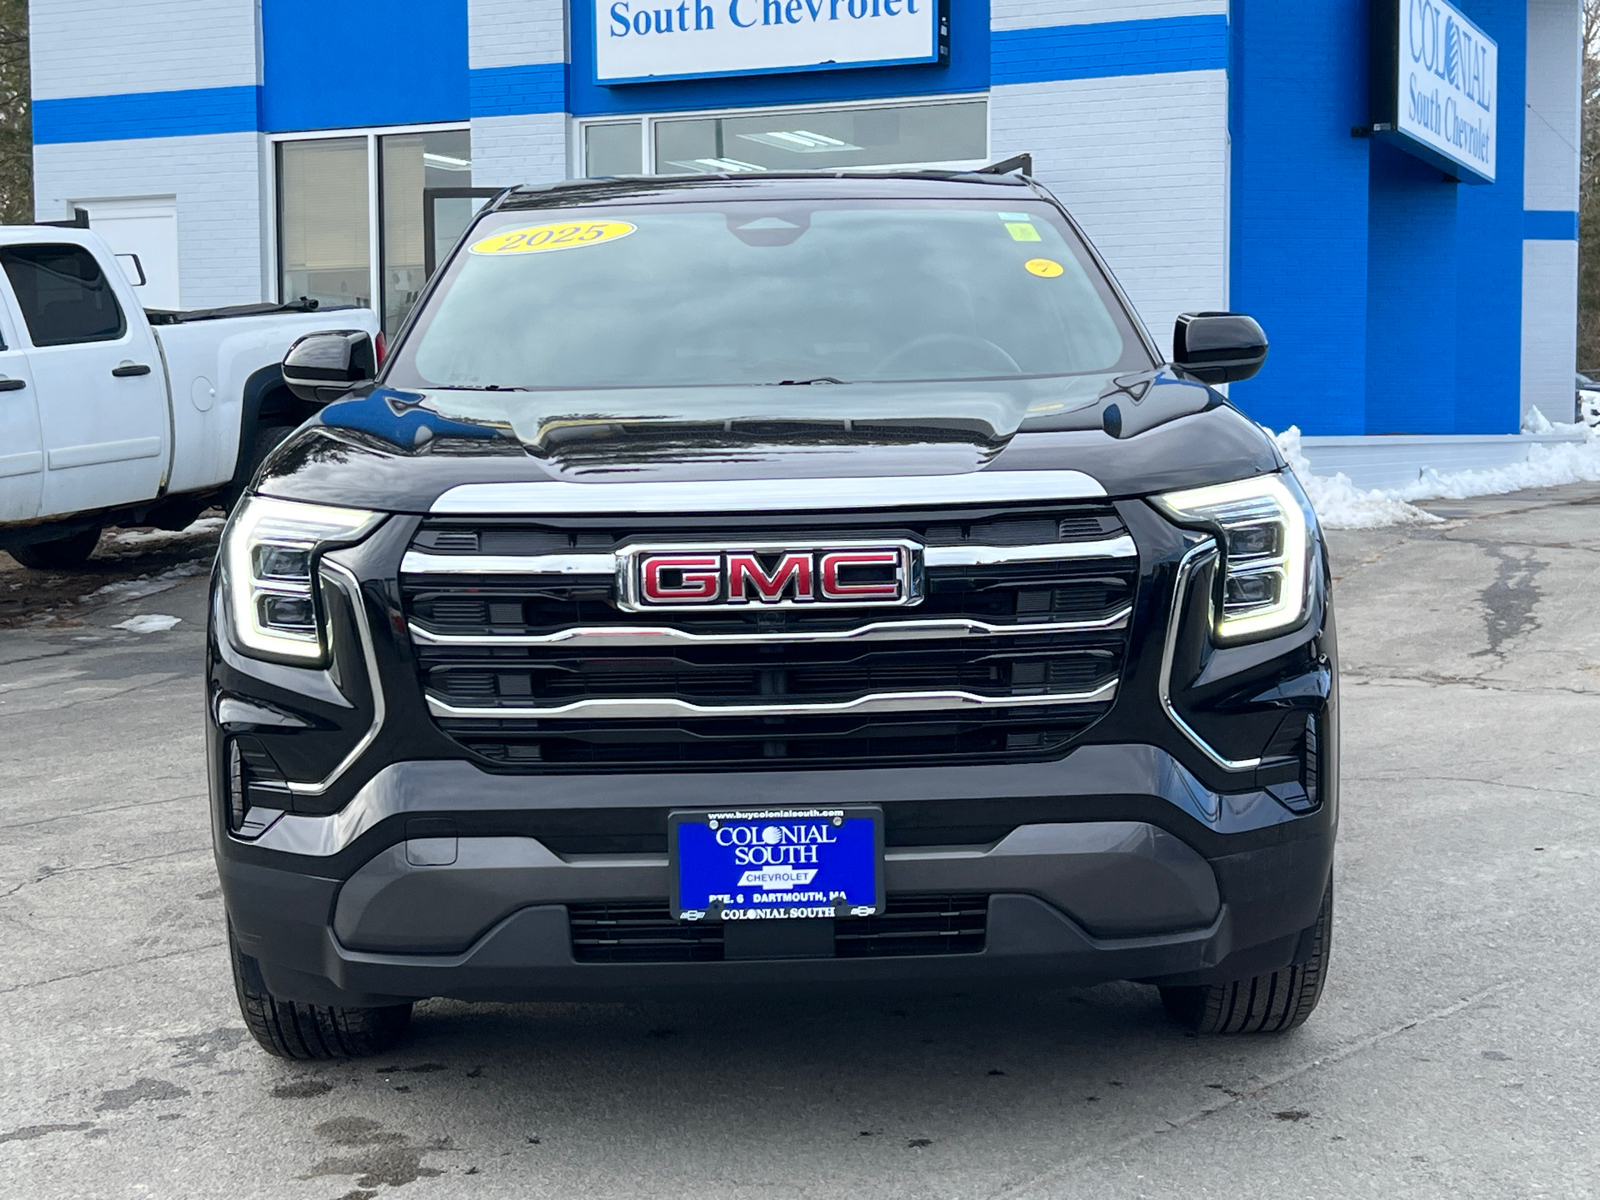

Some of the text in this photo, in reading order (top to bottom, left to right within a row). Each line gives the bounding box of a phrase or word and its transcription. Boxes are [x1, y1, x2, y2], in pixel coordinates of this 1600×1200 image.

[610, 0, 715, 37] South
[1409, 0, 1490, 112] COLONIAL
[1409, 72, 1490, 164] South Chevrolet
[498, 224, 609, 251] 2025
[642, 552, 898, 602] GMC
[708, 809, 844, 820] www.buycolonialsouth.com
[716, 825, 837, 846] COLONIAL
[735, 845, 819, 865] SOUTH
[746, 872, 809, 882] CHEVROLET
[736, 894, 744, 903] 6
[753, 892, 826, 903] DARTMOUTH,
[829, 891, 847, 900] MA
[721, 907, 835, 920] COLONIAL SOUTH
